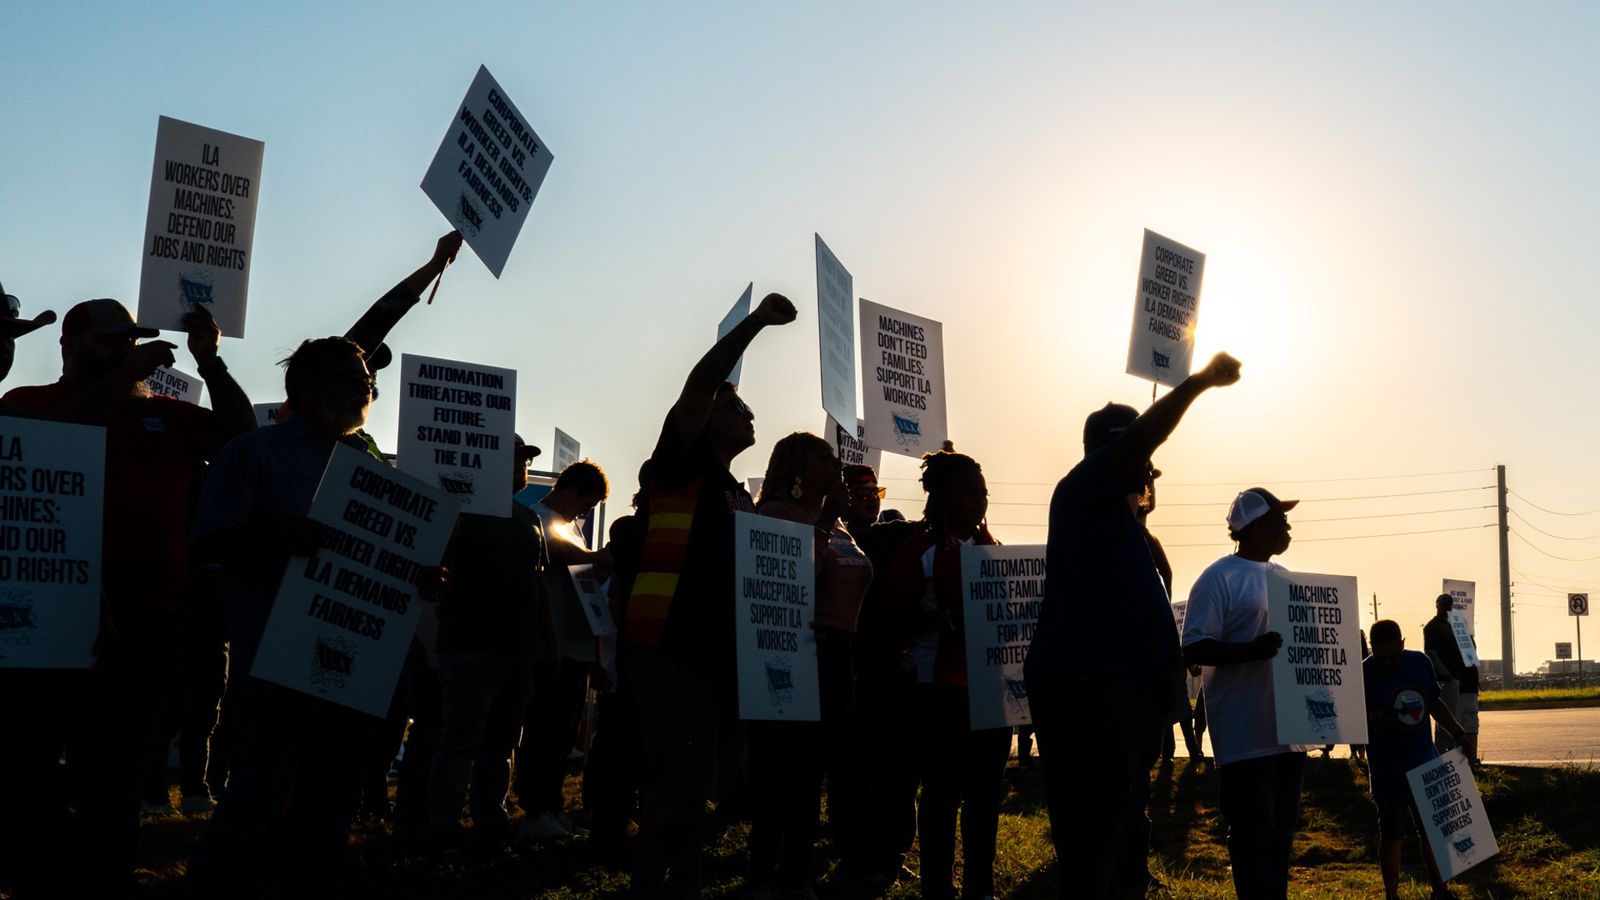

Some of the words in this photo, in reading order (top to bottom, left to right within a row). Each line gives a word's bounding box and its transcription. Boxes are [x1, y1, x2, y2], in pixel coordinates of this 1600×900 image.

[488, 88, 540, 158] CORPORATE
[482, 109, 513, 149] GREED
[511, 144, 526, 170] VS.
[202, 143, 219, 167] ILA
[460, 106, 500, 162] WORKER
[499, 156, 533, 205] RIGHTS:
[165, 160, 220, 192] WORKERS
[221, 174, 250, 198] OVER
[457, 131, 475, 159] ILA
[474, 152, 520, 213] DEMANDS
[458, 160, 503, 219] FAIRNESS
[173, 188, 235, 220] MACHINES:
[167, 213, 211, 241] DEFEND
[214, 222, 236, 244] OUR
[150, 235, 180, 260] JOBS
[180, 241, 204, 264] AND
[206, 246, 245, 271] RIGHTS
[1155, 246, 1194, 275] CORPORATE
[1142, 277, 1170, 302] WORKER
[1155, 264, 1177, 286] GREED
[1178, 274, 1188, 291] VS.
[1144, 298, 1156, 315] ILA
[1157, 303, 1190, 328] DEMANDS
[878, 315, 925, 342] MACHINES
[1148, 317, 1181, 342] FAIRNESS
[877, 332, 904, 354] DON'T
[905, 340, 927, 360] FEED
[418, 363, 503, 390] AUTOMATION
[881, 351, 925, 376] FAMILIES:
[166, 374, 189, 393] OVER
[876, 367, 917, 392] SUPPORT
[917, 378, 932, 395] ILA
[408, 382, 483, 407] THREATENS
[486, 394, 512, 411] OUR
[883, 386, 927, 411] WORKERS
[0, 435, 23, 461] LA
[417, 425, 462, 446] STAND
[465, 431, 500, 450] WITH
[433, 449, 457, 466] THE
[460, 452, 482, 469] ILA
[846, 450, 864, 464] FAIR
[31, 468, 84, 496] OVER
[350, 466, 439, 522] CORPORATE
[343, 500, 394, 538] GREED
[394, 520, 418, 550] VS.
[26, 528, 66, 554] OUR
[750, 529, 779, 553] PROFIT
[780, 535, 802, 558] OVER
[17, 557, 89, 585] RIGHTS
[756, 555, 787, 579] PEOPLE
[789, 560, 797, 580] IS
[303, 556, 333, 586] ILA
[334, 568, 411, 616] DEMANDS
[743, 578, 809, 606] UNACCEPTABLE:
[970, 581, 1006, 600] HURTS
[1289, 584, 1338, 605] MACHINES
[308, 594, 385, 640] FAIRNESS
[750, 603, 788, 626] SUPPORT
[789, 608, 802, 628] ILA
[986, 603, 1005, 622] ILA
[1288, 605, 1316, 623] DON'T
[1318, 607, 1342, 625] FEED
[756, 628, 798, 652] WORKERS
[997, 624, 1018, 643] FOR
[1293, 626, 1339, 645] FAMILIES:
[1288, 646, 1329, 665] SUPPORT
[1332, 648, 1347, 666] ILA
[1295, 668, 1342, 686] WORKERS
[1422, 760, 1456, 786] MACHINES
[1425, 780, 1444, 800] DON'T
[1444, 773, 1461, 790] FEED
[1431, 788, 1463, 812] FAMILIES:
[1432, 803, 1461, 826] SUPPORT
[1461, 798, 1472, 814] ILA
[1440, 813, 1473, 838] WORKERS
